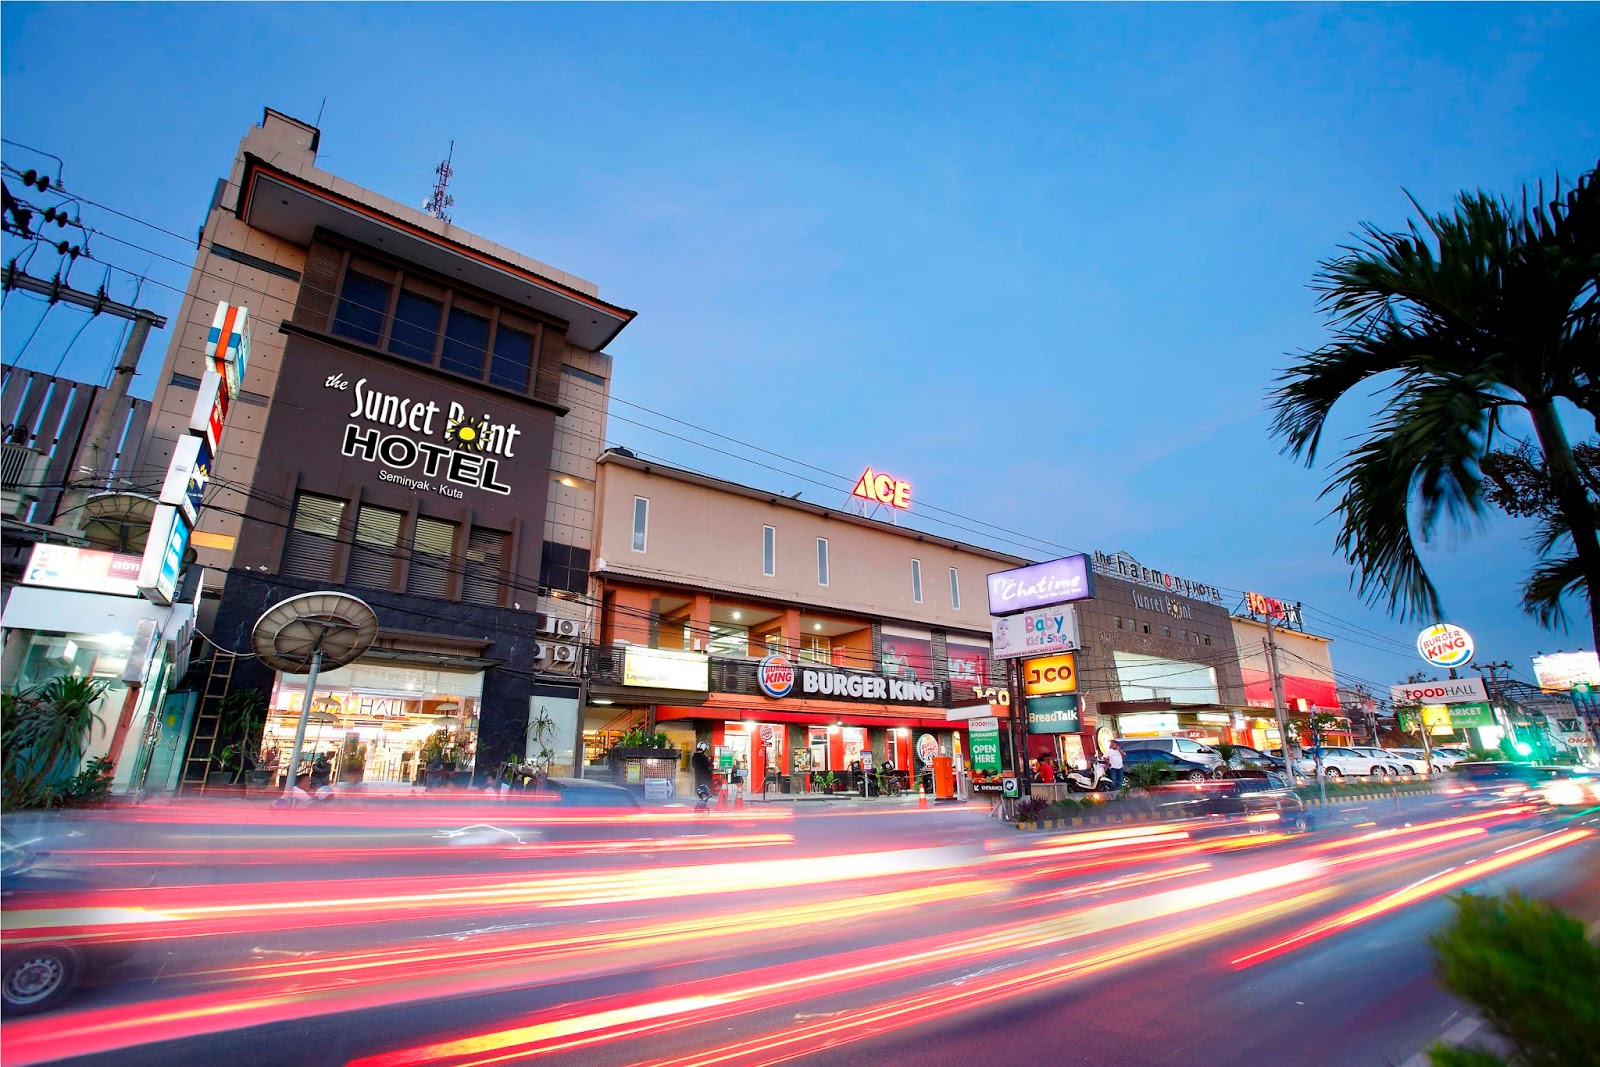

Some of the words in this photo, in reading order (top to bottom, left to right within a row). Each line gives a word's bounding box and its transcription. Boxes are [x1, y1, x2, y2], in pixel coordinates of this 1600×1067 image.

[324, 373, 348, 390] the
[350, 378, 440, 435] Sunset
[341, 423, 511, 495] HOTEL
[378, 470, 429, 491] Seminyak
[439, 485, 463, 499] Kuta
[853, 466, 911, 509] ACE
[112, 559, 140, 572] atm
[1094, 550, 1112, 565] the
[1115, 553, 1190, 597] harmony
[1191, 582, 1222, 601] HOTEL
[1001, 576, 1081, 600] Chatime
[1131, 589, 1164, 613] Sunset
[1249, 592, 1307, 627] FOODHAL
[1024, 613, 1064, 634] Baby
[1026, 636, 1044, 647] Kid's
[1047, 633, 1067, 645] Shop
[1423, 630, 1461, 650] BURGER
[1427, 637, 1465, 660] KING
[765, 664, 792, 674] BURGER
[765, 672, 792, 684] KING
[802, 670, 887, 699] BURGER
[889, 679, 935, 702] KING
[1405, 684, 1476, 700] FOODHALL
[1029, 709, 1078, 723] BreadTalk
[972, 744, 997, 754] OPEN
[974, 754, 996, 763] HERE
